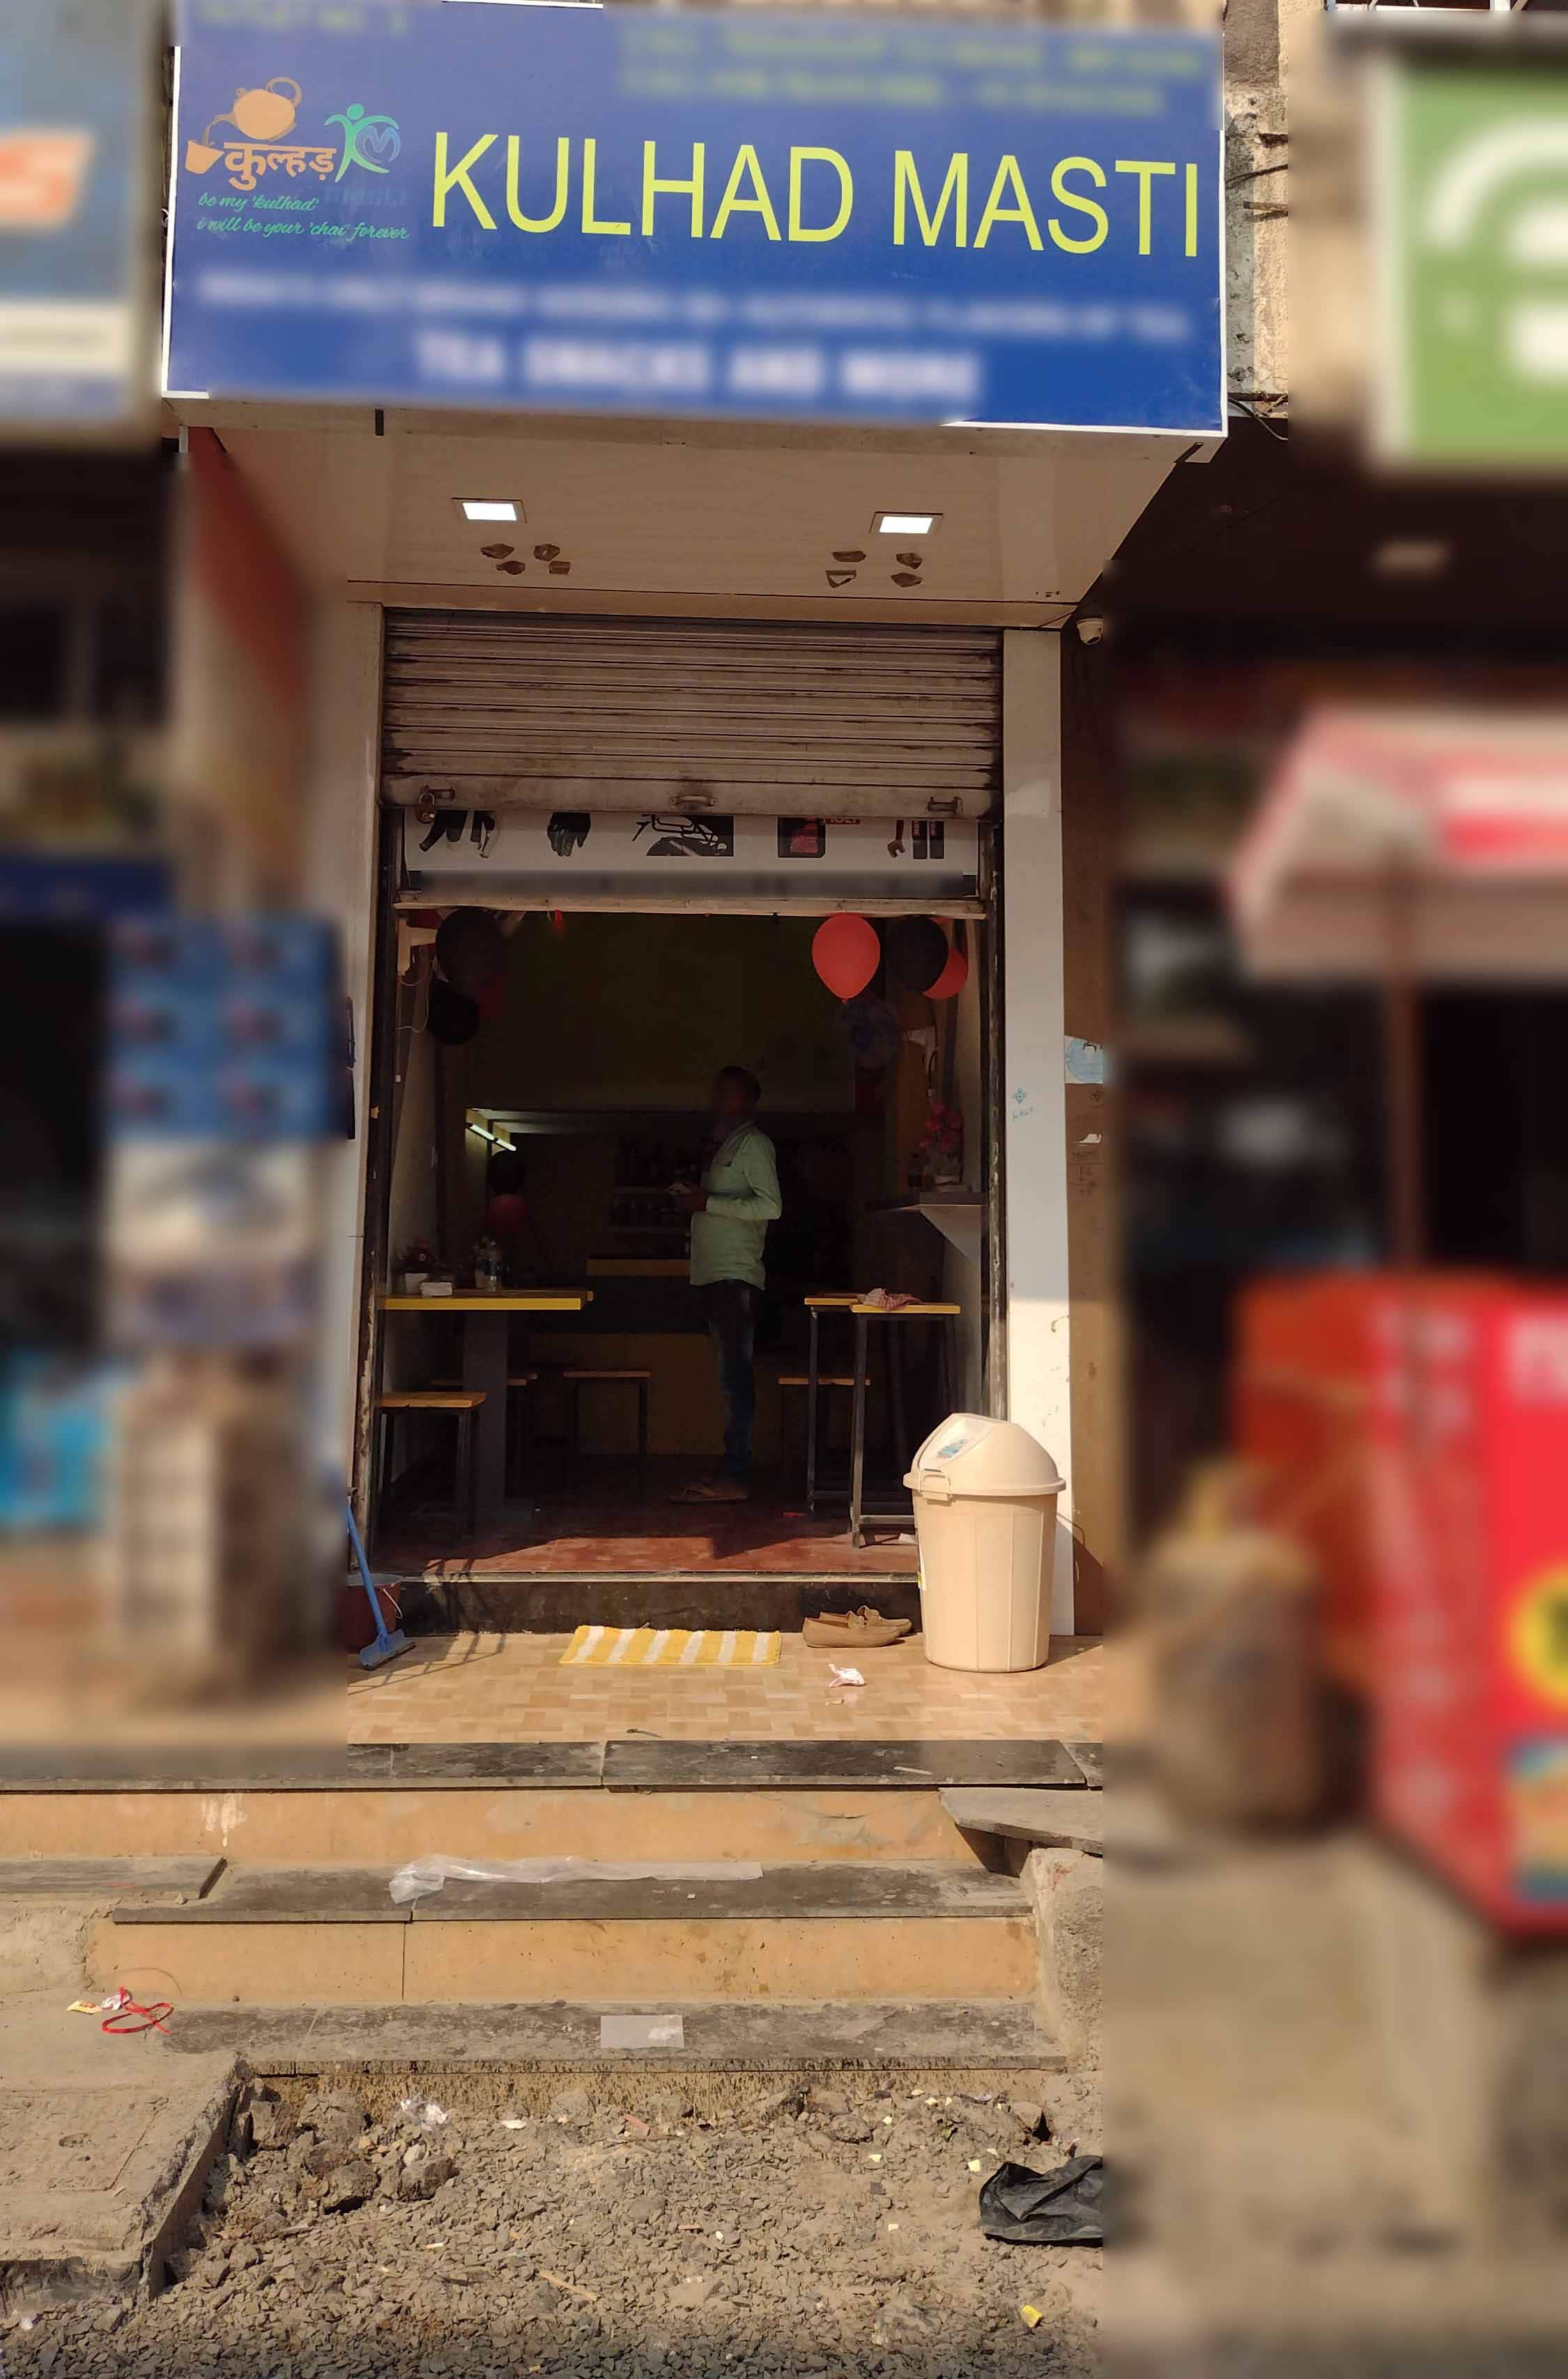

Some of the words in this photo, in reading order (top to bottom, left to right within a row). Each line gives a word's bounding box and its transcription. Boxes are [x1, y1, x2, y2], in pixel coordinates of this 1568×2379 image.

[224, 142, 337, 191] कुल्हड़
[198, 192, 215, 206] be
[220, 196, 247, 212] my
[433, 133, 853, 241] KULHAD
[894, 151, 1197, 257] MASTI
[208, 217, 241, 231] will
[244, 218, 263, 232] be
[264, 222, 305, 238] your
[346, 223, 410, 243] forever
